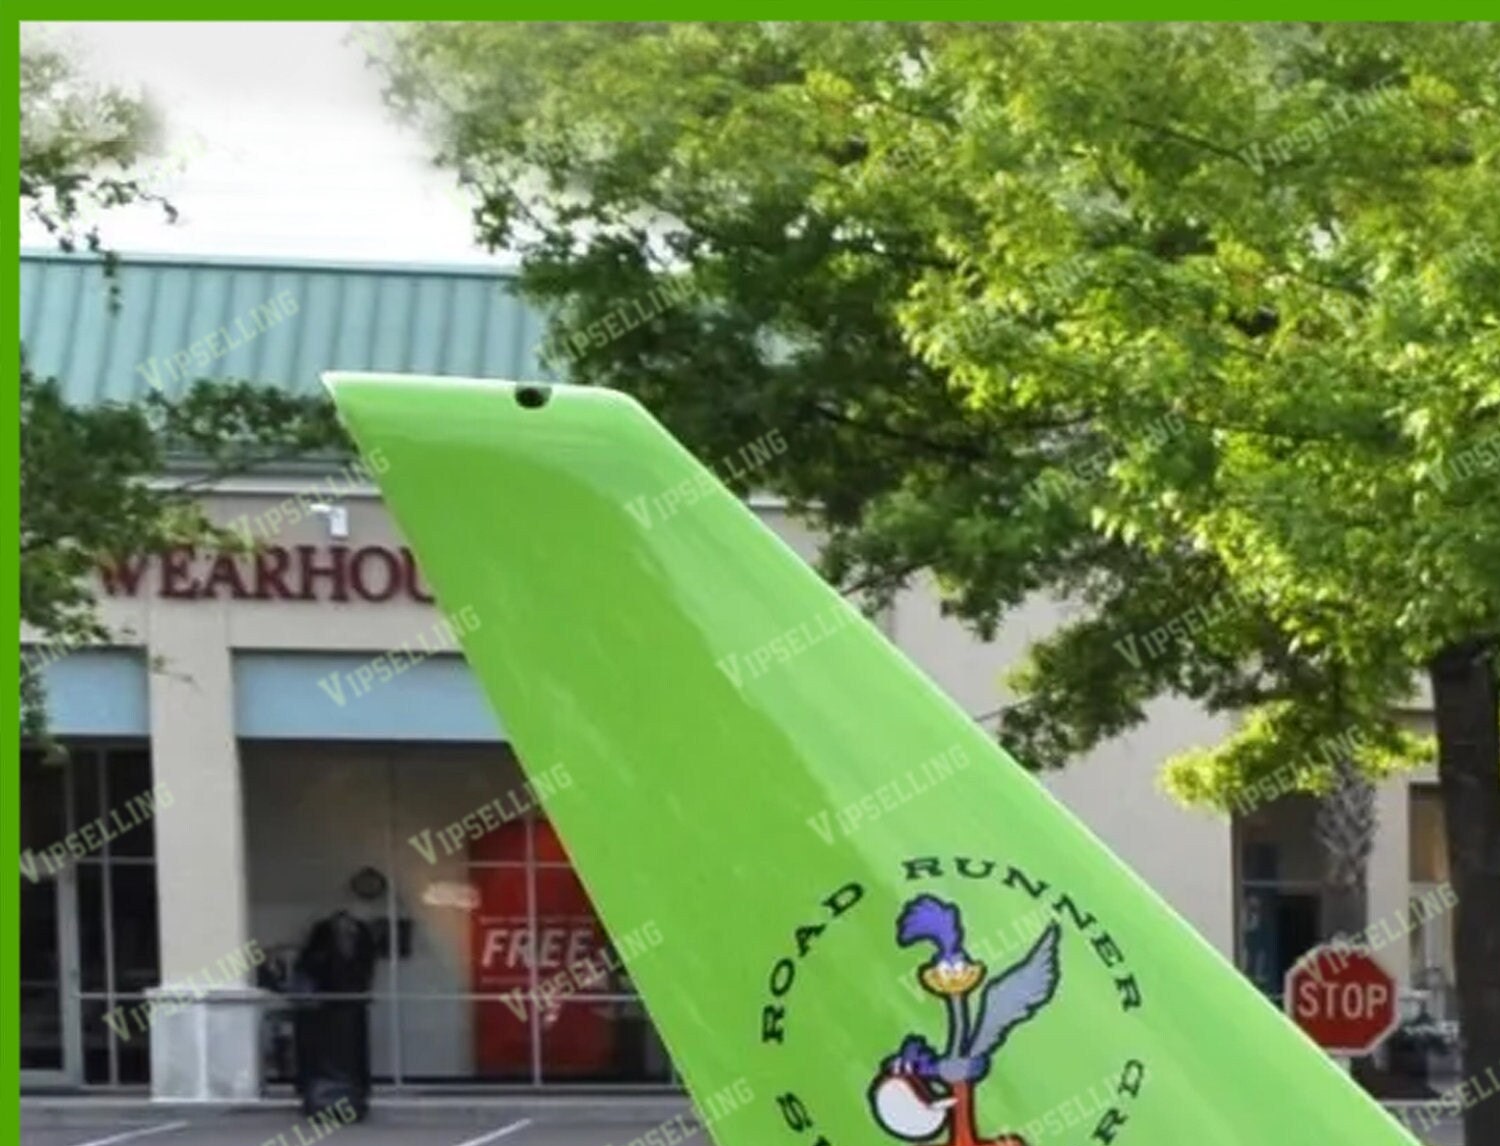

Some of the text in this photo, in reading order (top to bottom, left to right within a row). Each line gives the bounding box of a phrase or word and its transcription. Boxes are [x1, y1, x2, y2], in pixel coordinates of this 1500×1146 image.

[481, 927, 594, 969] FREE
[762, 857, 1142, 1045] ROAD RUNNER
[1297, 980, 1388, 1021] STOP
